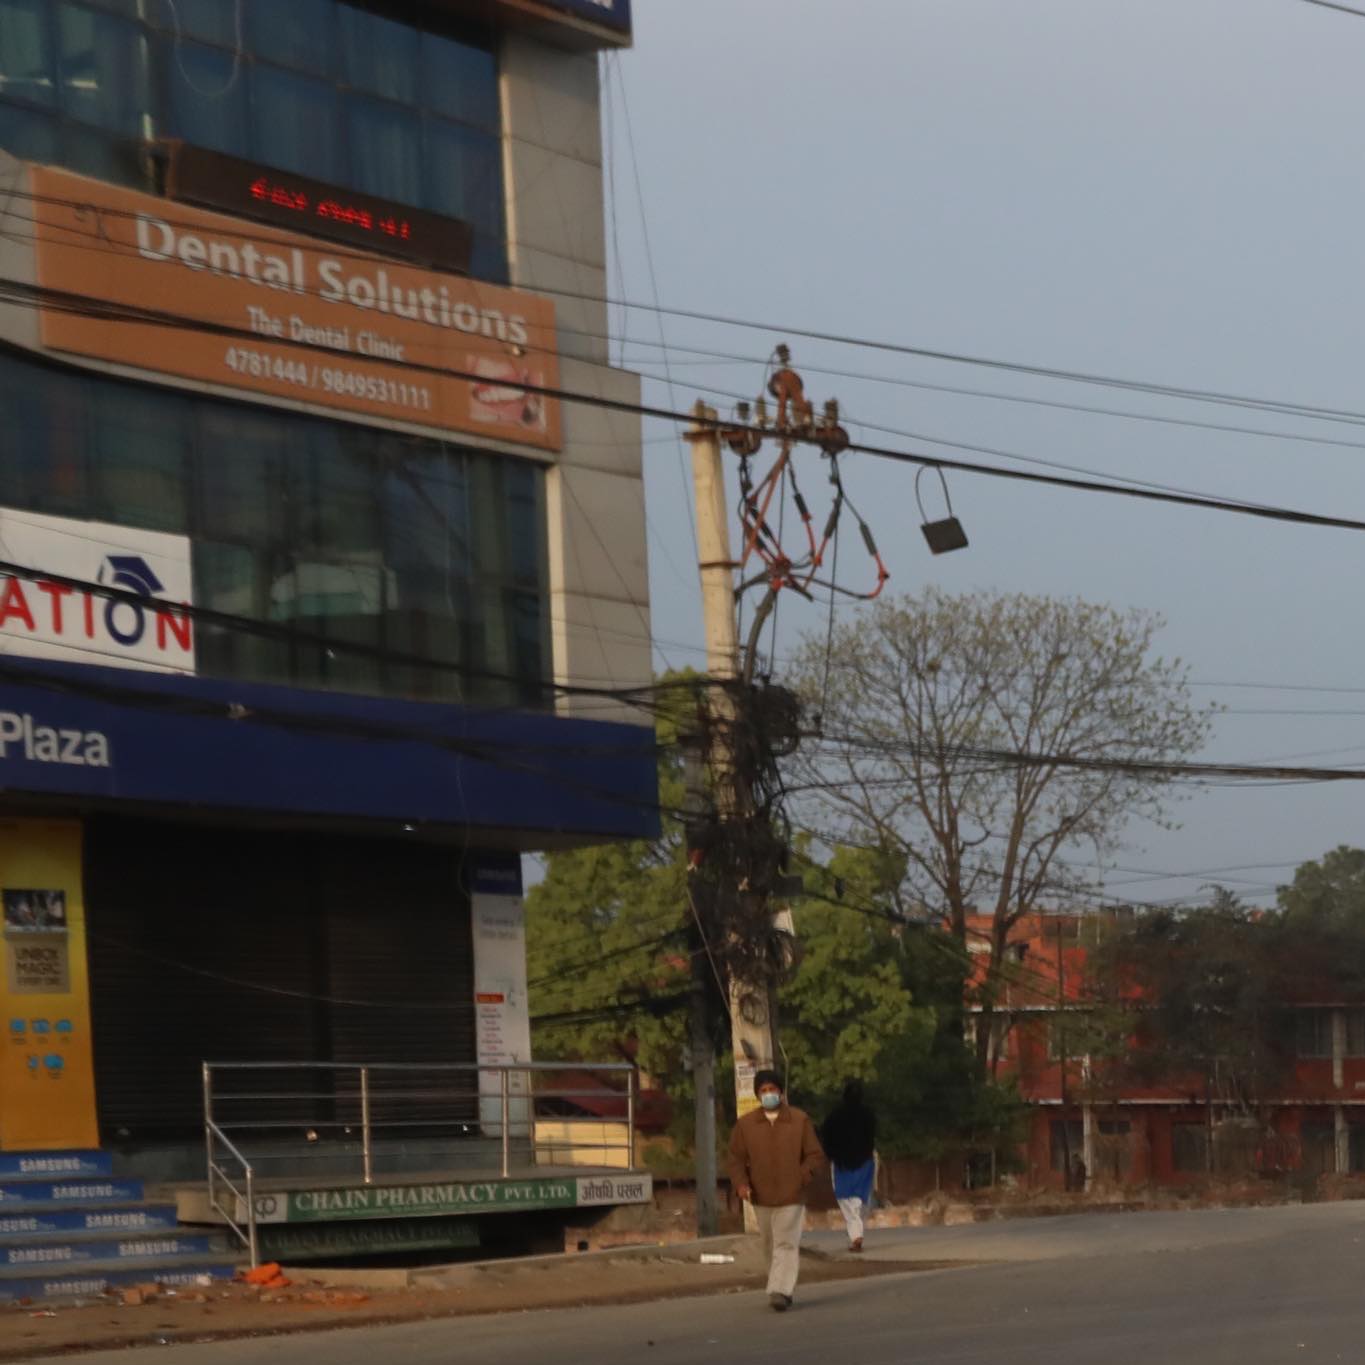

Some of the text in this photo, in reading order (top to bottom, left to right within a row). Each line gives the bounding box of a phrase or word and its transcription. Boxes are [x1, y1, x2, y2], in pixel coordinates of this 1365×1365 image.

[136, 214, 528, 344] Dental Solutions
[246, 305, 405, 361] The Dental Clinic
[225, 347, 308, 385] 4781444
[322, 368, 431, 410] 9849531111
[0, 711, 110, 768] Plaza
[19, 1158, 81, 1172] SAMSUNG
[53, 1184, 113, 1199] SAMSUNG
[296, 1190, 369, 1211] CHAIN
[376, 1183, 499, 1208] PHARMACY
[85, 1213, 147, 1228] SAMSUNG
[8, 1248, 72, 1264] SAMSUNG
[119, 1240, 179, 1256] SAMSUNG
